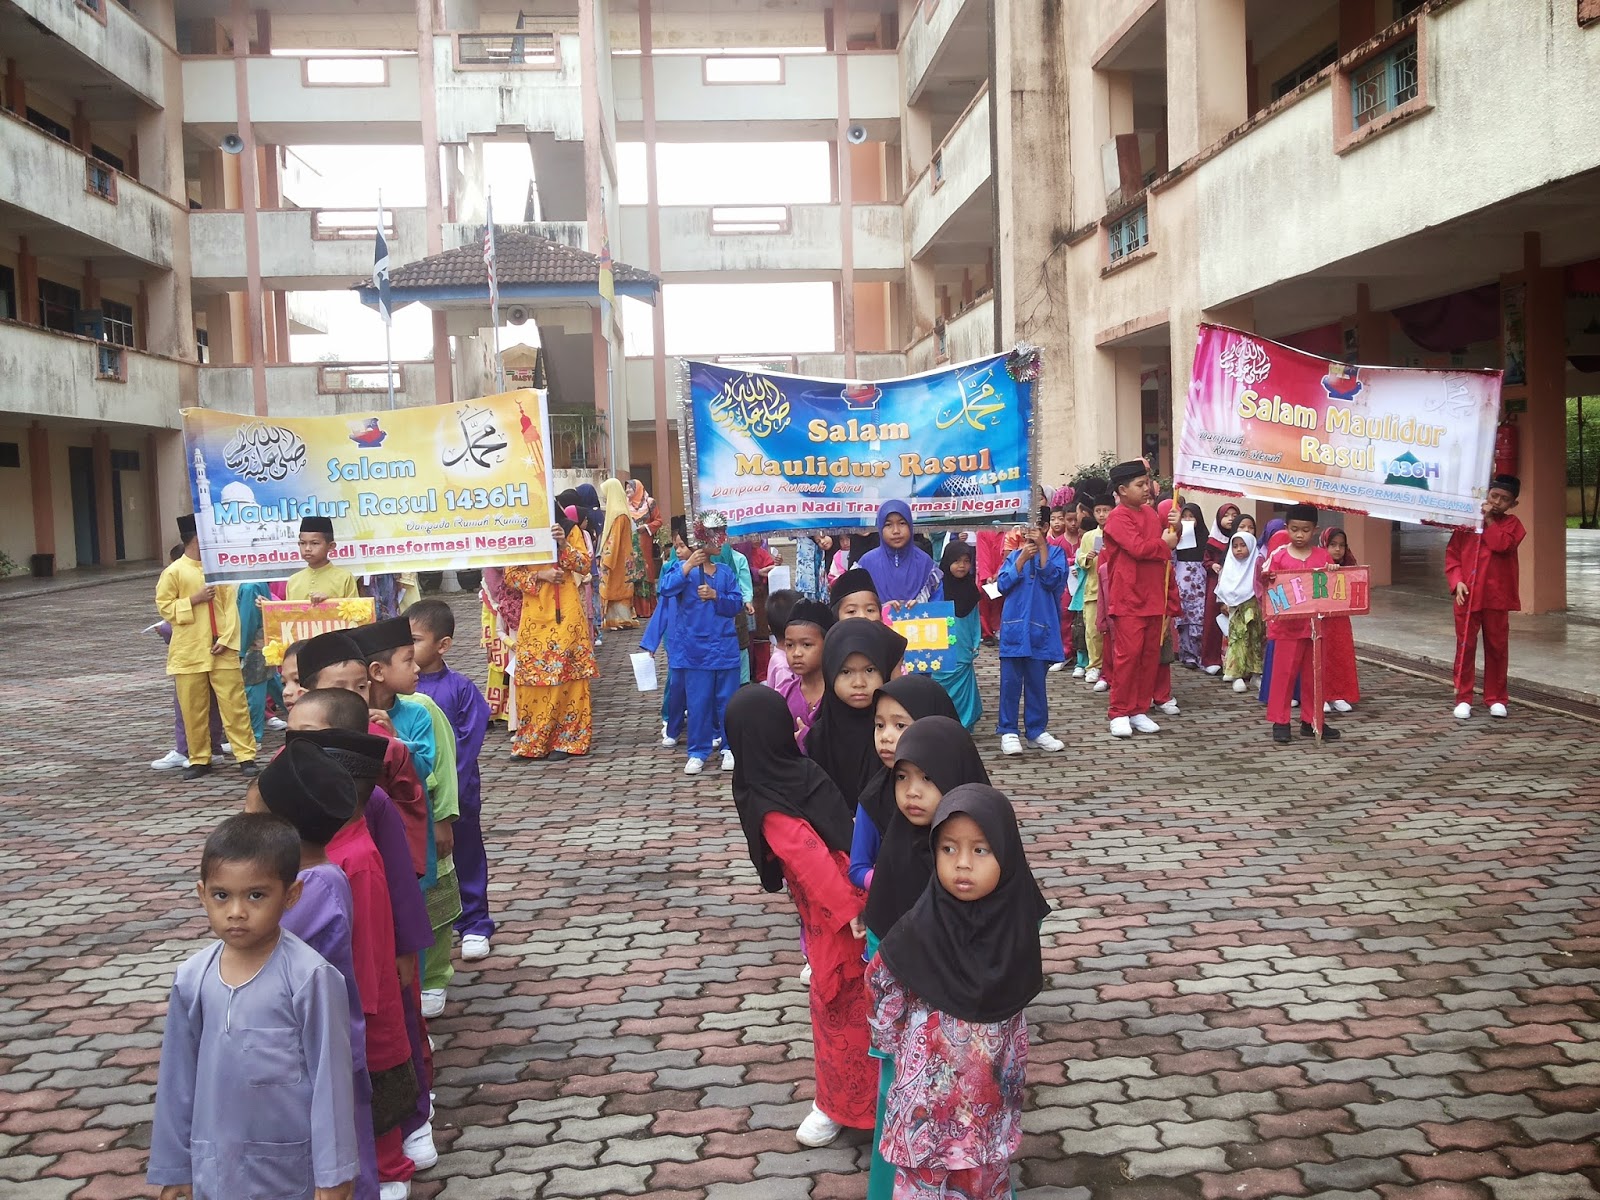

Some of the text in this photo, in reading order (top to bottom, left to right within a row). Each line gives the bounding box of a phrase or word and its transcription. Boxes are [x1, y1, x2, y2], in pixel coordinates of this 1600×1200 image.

[808, 418, 910, 442] Salam
[1238, 390, 1447, 447] Salam Maulidur
[735, 448, 991, 478] Maulidur Rasul
[1301, 435, 1375, 472] Rasul
[327, 456, 416, 482] Salam
[969, 467, 1020, 485] 1436H
[1191, 460, 1273, 481] PERPADUAN
[1277, 473, 1309, 487] NADI
[1382, 460, 1439, 478] 1436H
[778, 481, 827, 494] Rumah
[832, 482, 863, 494] Biru
[213, 483, 529, 525] Maulidur Rasul 1436H
[709, 504, 797, 521] erpaduan
[802, 501, 841, 513] Nadi
[961, 497, 1021, 512] Negara
[218, 535, 534, 566] Perpadua adi Transformasi Negara
[1267, 571, 1367, 614] MERAH
